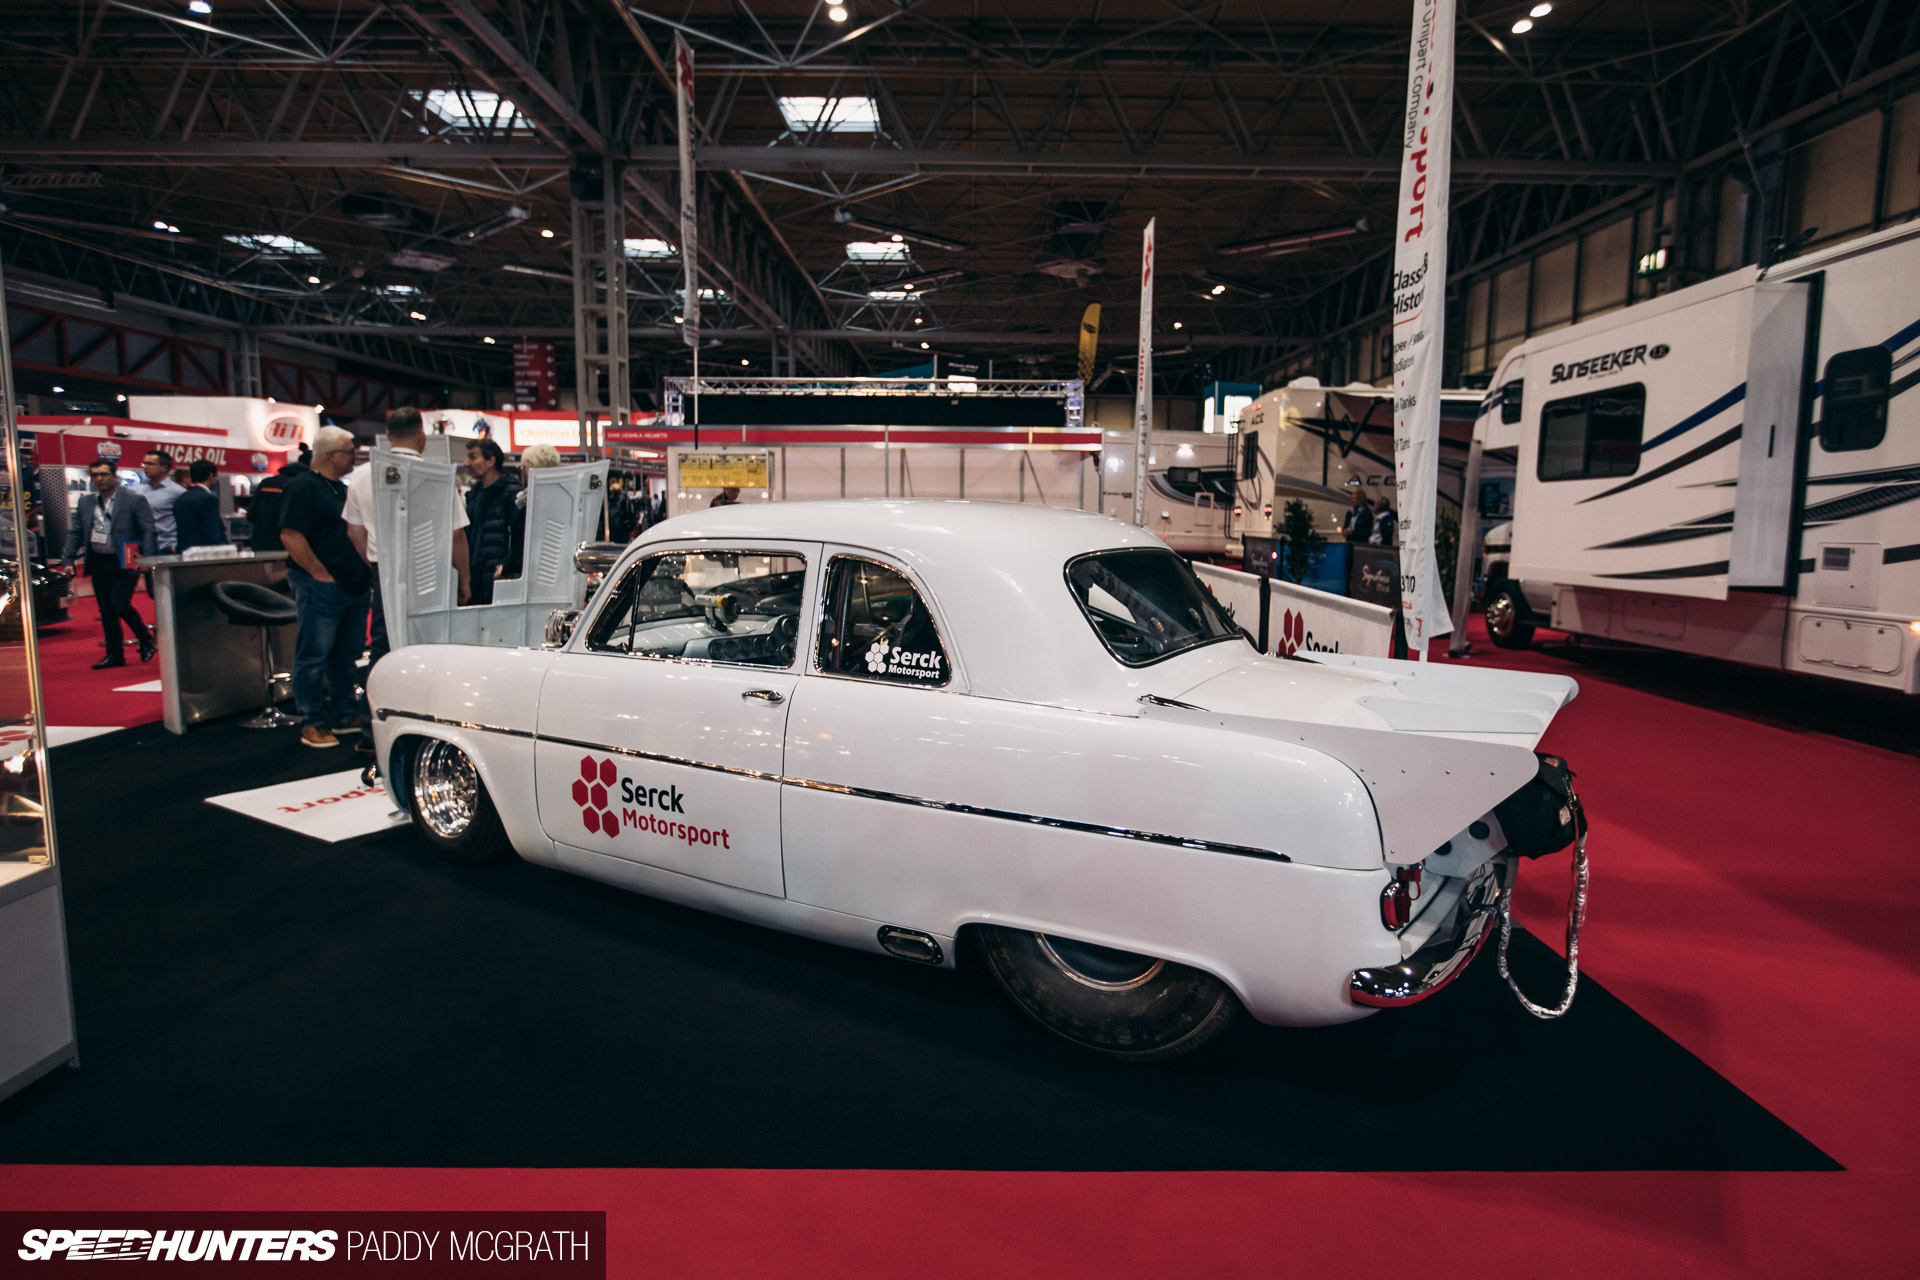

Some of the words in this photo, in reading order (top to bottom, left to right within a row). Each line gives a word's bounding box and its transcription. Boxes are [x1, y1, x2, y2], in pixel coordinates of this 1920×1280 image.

[1416, 14, 1430, 71] Unipart
[1404, 74, 1423, 149] company
[205, 449, 227, 465] OIL
[888, 664, 940, 679] Motorsport
[889, 646, 942, 669] Serck
[621, 777, 685, 814] Serck
[622, 807, 730, 850] Motorsport
